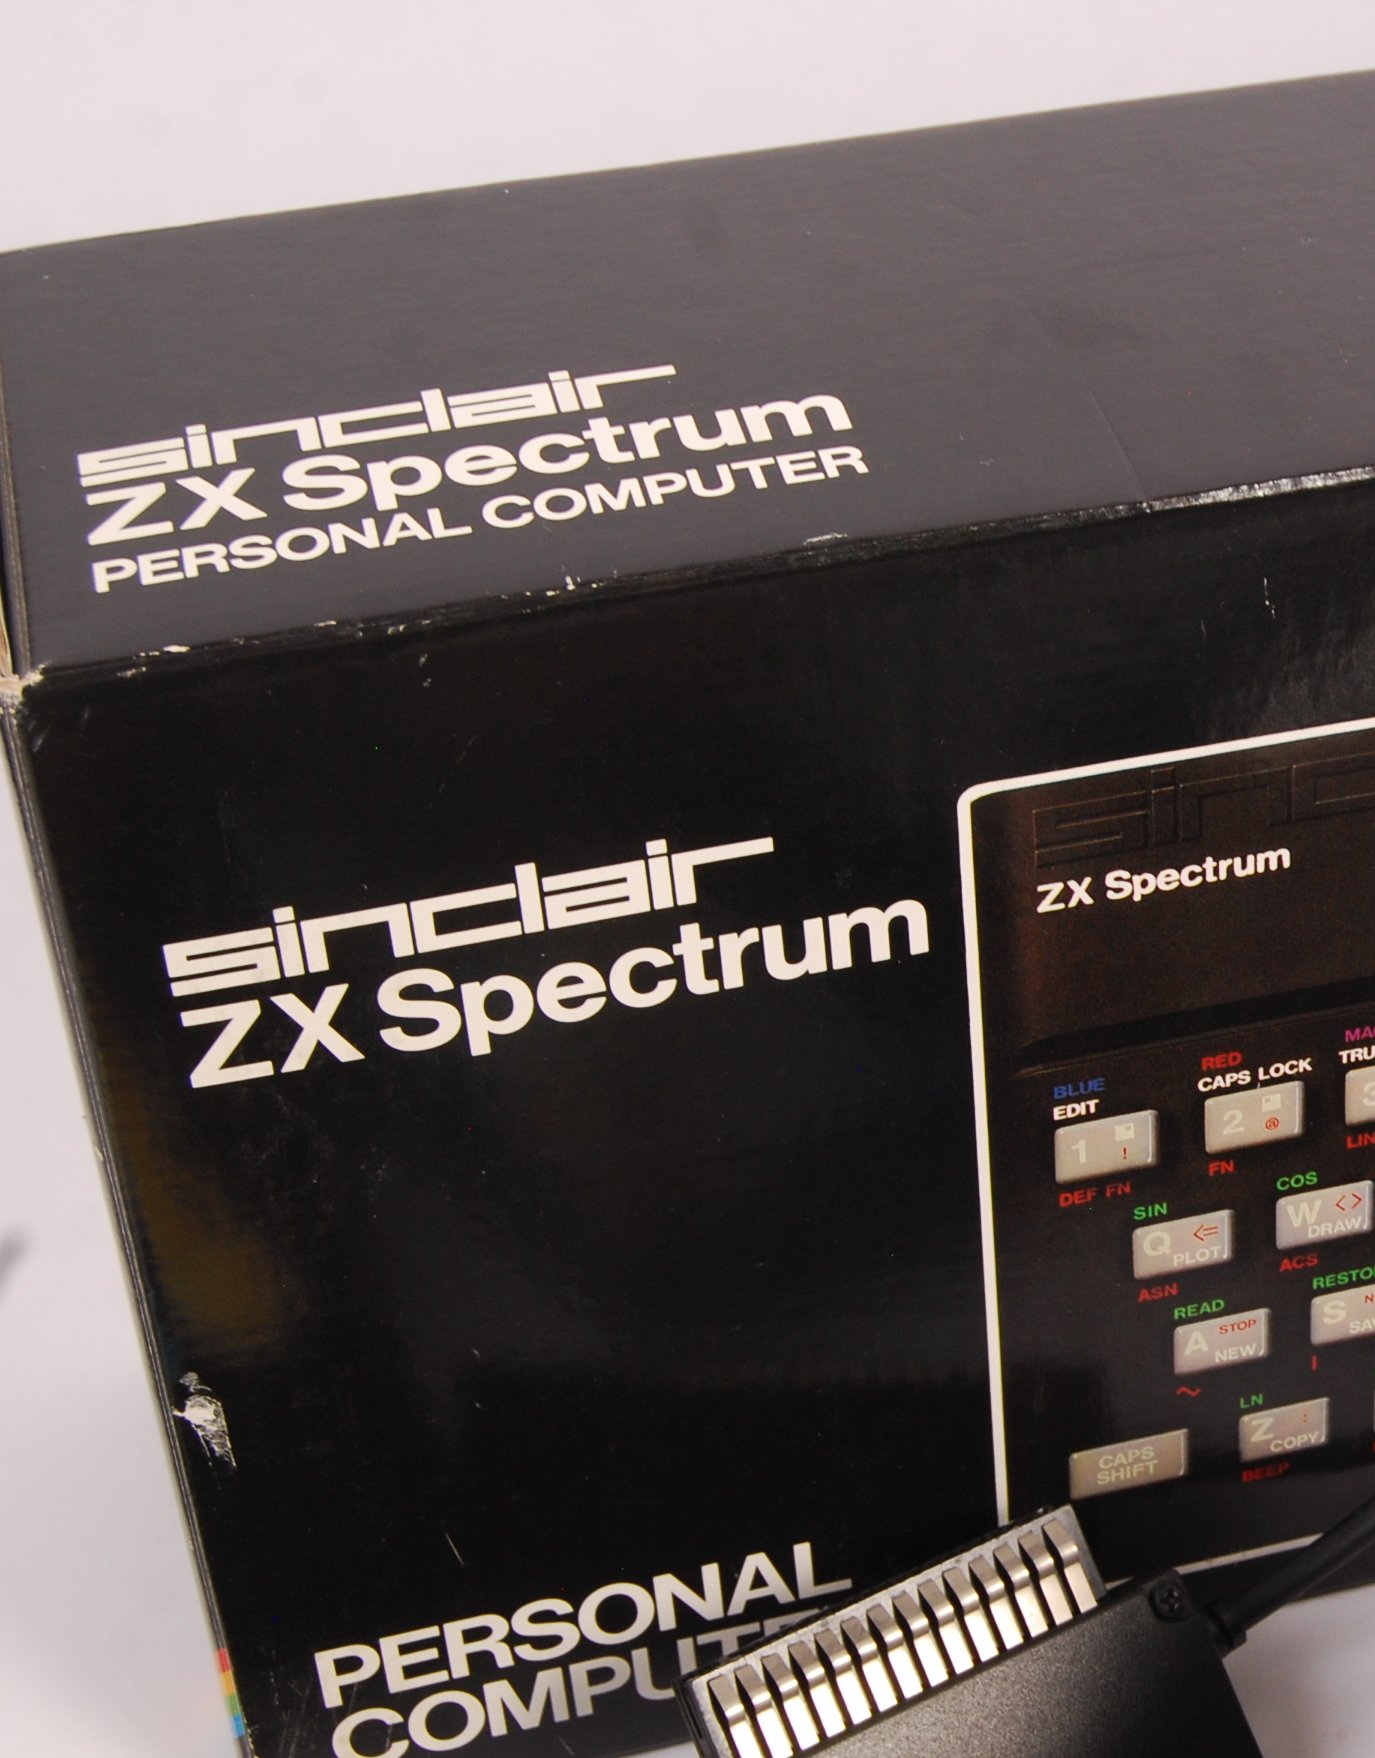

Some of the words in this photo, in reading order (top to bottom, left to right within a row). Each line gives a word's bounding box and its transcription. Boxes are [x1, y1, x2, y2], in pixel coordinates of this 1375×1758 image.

[76, 365, 677, 486] sinclair
[85, 468, 267, 546] ZX
[281, 394, 853, 513] Spectrum
[91, 508, 472, 593] PERSONAL
[482, 446, 869, 529] COMPUTER
[1036, 878, 1093, 914] ZX
[1105, 847, 1291, 902] Spectrum
[163, 837, 774, 996] sinclair
[180, 984, 365, 1088] ZX
[377, 898, 929, 1057] Spectrum
[1202, 1052, 1242, 1070] RED
[1198, 1070, 1251, 1092] CAPS
[1258, 1058, 1312, 1080] LOCK
[1054, 1079, 1105, 1099] BLUE
[1053, 1100, 1099, 1121] EDIT
[1223, 1110, 1244, 1136] 2
[1072, 1141, 1087, 1164] 1
[1208, 1160, 1235, 1176] FN
[1277, 1172, 1318, 1190] COS
[1059, 1189, 1097, 1207] DEF
[1106, 1182, 1132, 1197] FN
[1133, 1203, 1167, 1220] SIN
[1287, 1200, 1322, 1228] W
[1308, 1217, 1362, 1238] DRAW
[1143, 1231, 1172, 1255] Q
[1174, 1246, 1222, 1266] PLOT
[1280, 1254, 1319, 1271] ACS
[1138, 1283, 1179, 1301] ASN
[1174, 1300, 1224, 1320] READ
[1322, 1300, 1347, 1324] S
[1219, 1320, 1256, 1334] STOP
[1184, 1331, 1208, 1356] A
[1215, 1344, 1256, 1363] NEW
[1239, 1394, 1263, 1409] LN
[1251, 1418, 1274, 1442] Z
[1270, 1432, 1318, 1452] COPY
[1099, 1447, 1154, 1470] CAPS
[1096, 1460, 1157, 1485] SHIFT
[314, 1542, 852, 1708] PERSONAL
